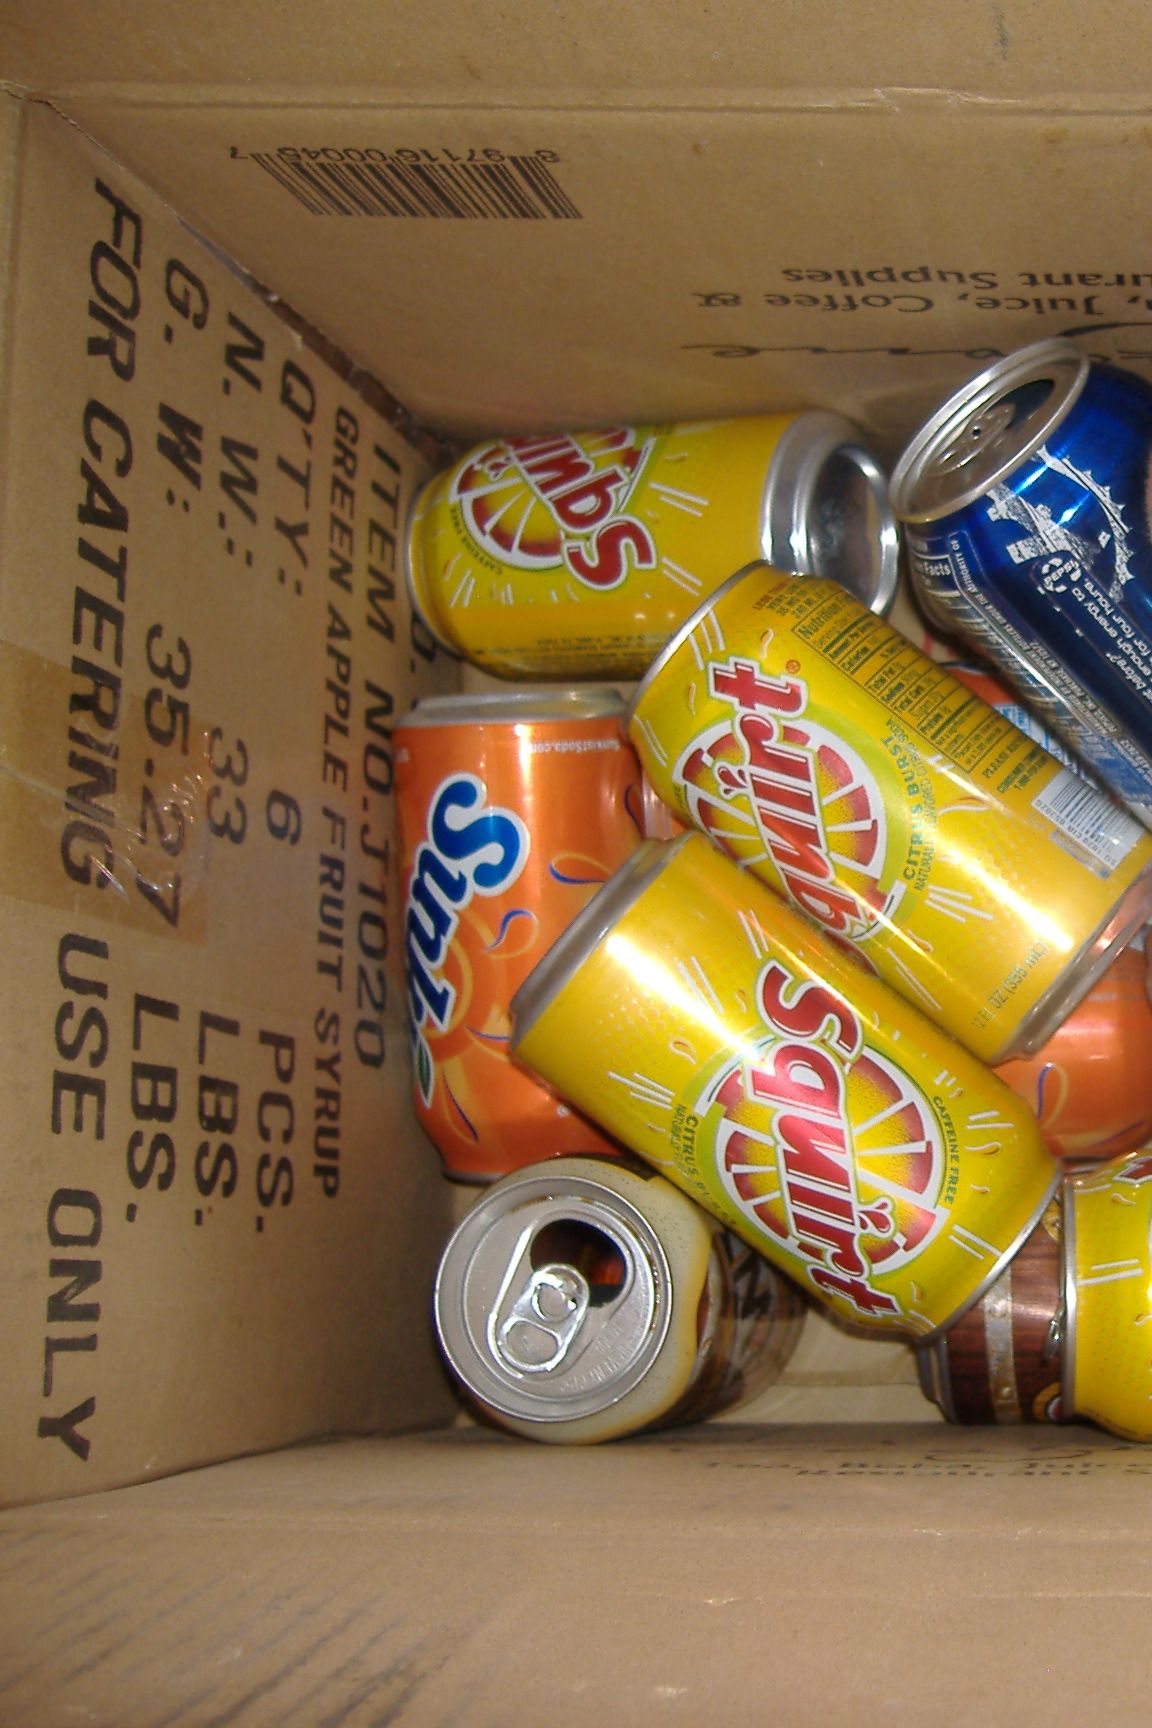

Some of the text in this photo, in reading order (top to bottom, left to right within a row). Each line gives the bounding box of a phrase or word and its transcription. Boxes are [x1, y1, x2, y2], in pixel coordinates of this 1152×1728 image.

[163, 258, 211, 344] G.
[692, 290, 744, 308] &
[765, 287, 933, 312] Coffee
[782, 265, 1000, 291] Supplies
[978, 287, 1100, 315] Juice,
[222, 312, 268, 398] N.
[362, 441, 403, 638] ITEM
[1069, 585, 1086, 602] to
[1077, 576, 1118, 615] hours.
[1080, 599, 1122, 639] energy
[1108, 611, 1137, 639] four
[1130, 636, 1152, 658] for
[36, 179, 143, 1462] FOR CATERING USE ONLY
[134, 623, 192, 928] 35.27
[206, 725, 250, 846] 33
[256, 359, 317, 1234] Q'TY: 6 PCS.
[311, 405, 360, 1198] GREEN APPLE FRUIT SYRUP
[708, 652, 857, 937] quirt
[879, 733, 922, 880] CITRUS BURST
[404, 771, 531, 1033] Sunk
[126, 993, 180, 1224] LBS.
[193, 1009, 240, 1228] LBS.
[674, 1114, 711, 1176] CITRUS
[743, 958, 906, 1322] Squirt
[931, 1094, 961, 1205] CAFFEINE FREE
